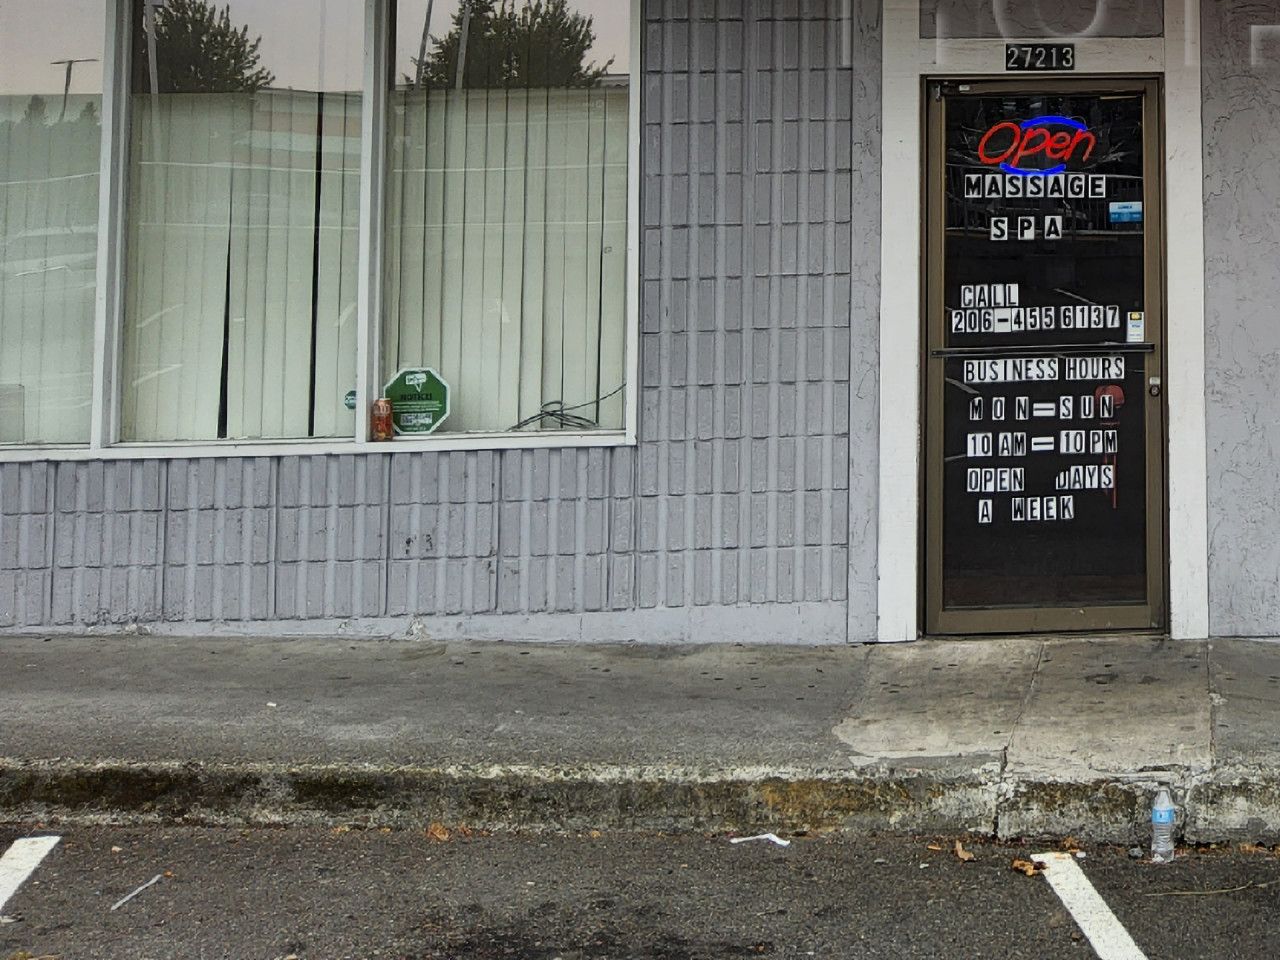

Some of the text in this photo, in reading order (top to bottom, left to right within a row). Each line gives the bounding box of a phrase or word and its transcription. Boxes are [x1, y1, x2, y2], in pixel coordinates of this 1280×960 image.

[1007, 47, 1073, 68] 27213
[978, 122, 1096, 167] Open
[966, 175, 1105, 197] MASSAGE
[992, 218, 1061, 239] SPA
[962, 285, 1018, 306] CALL
[965, 358, 1123, 382] BUSINESS HOURS
[968, 469, 1023, 491] OPEN
[980, 497, 1073, 522] A WEEK
